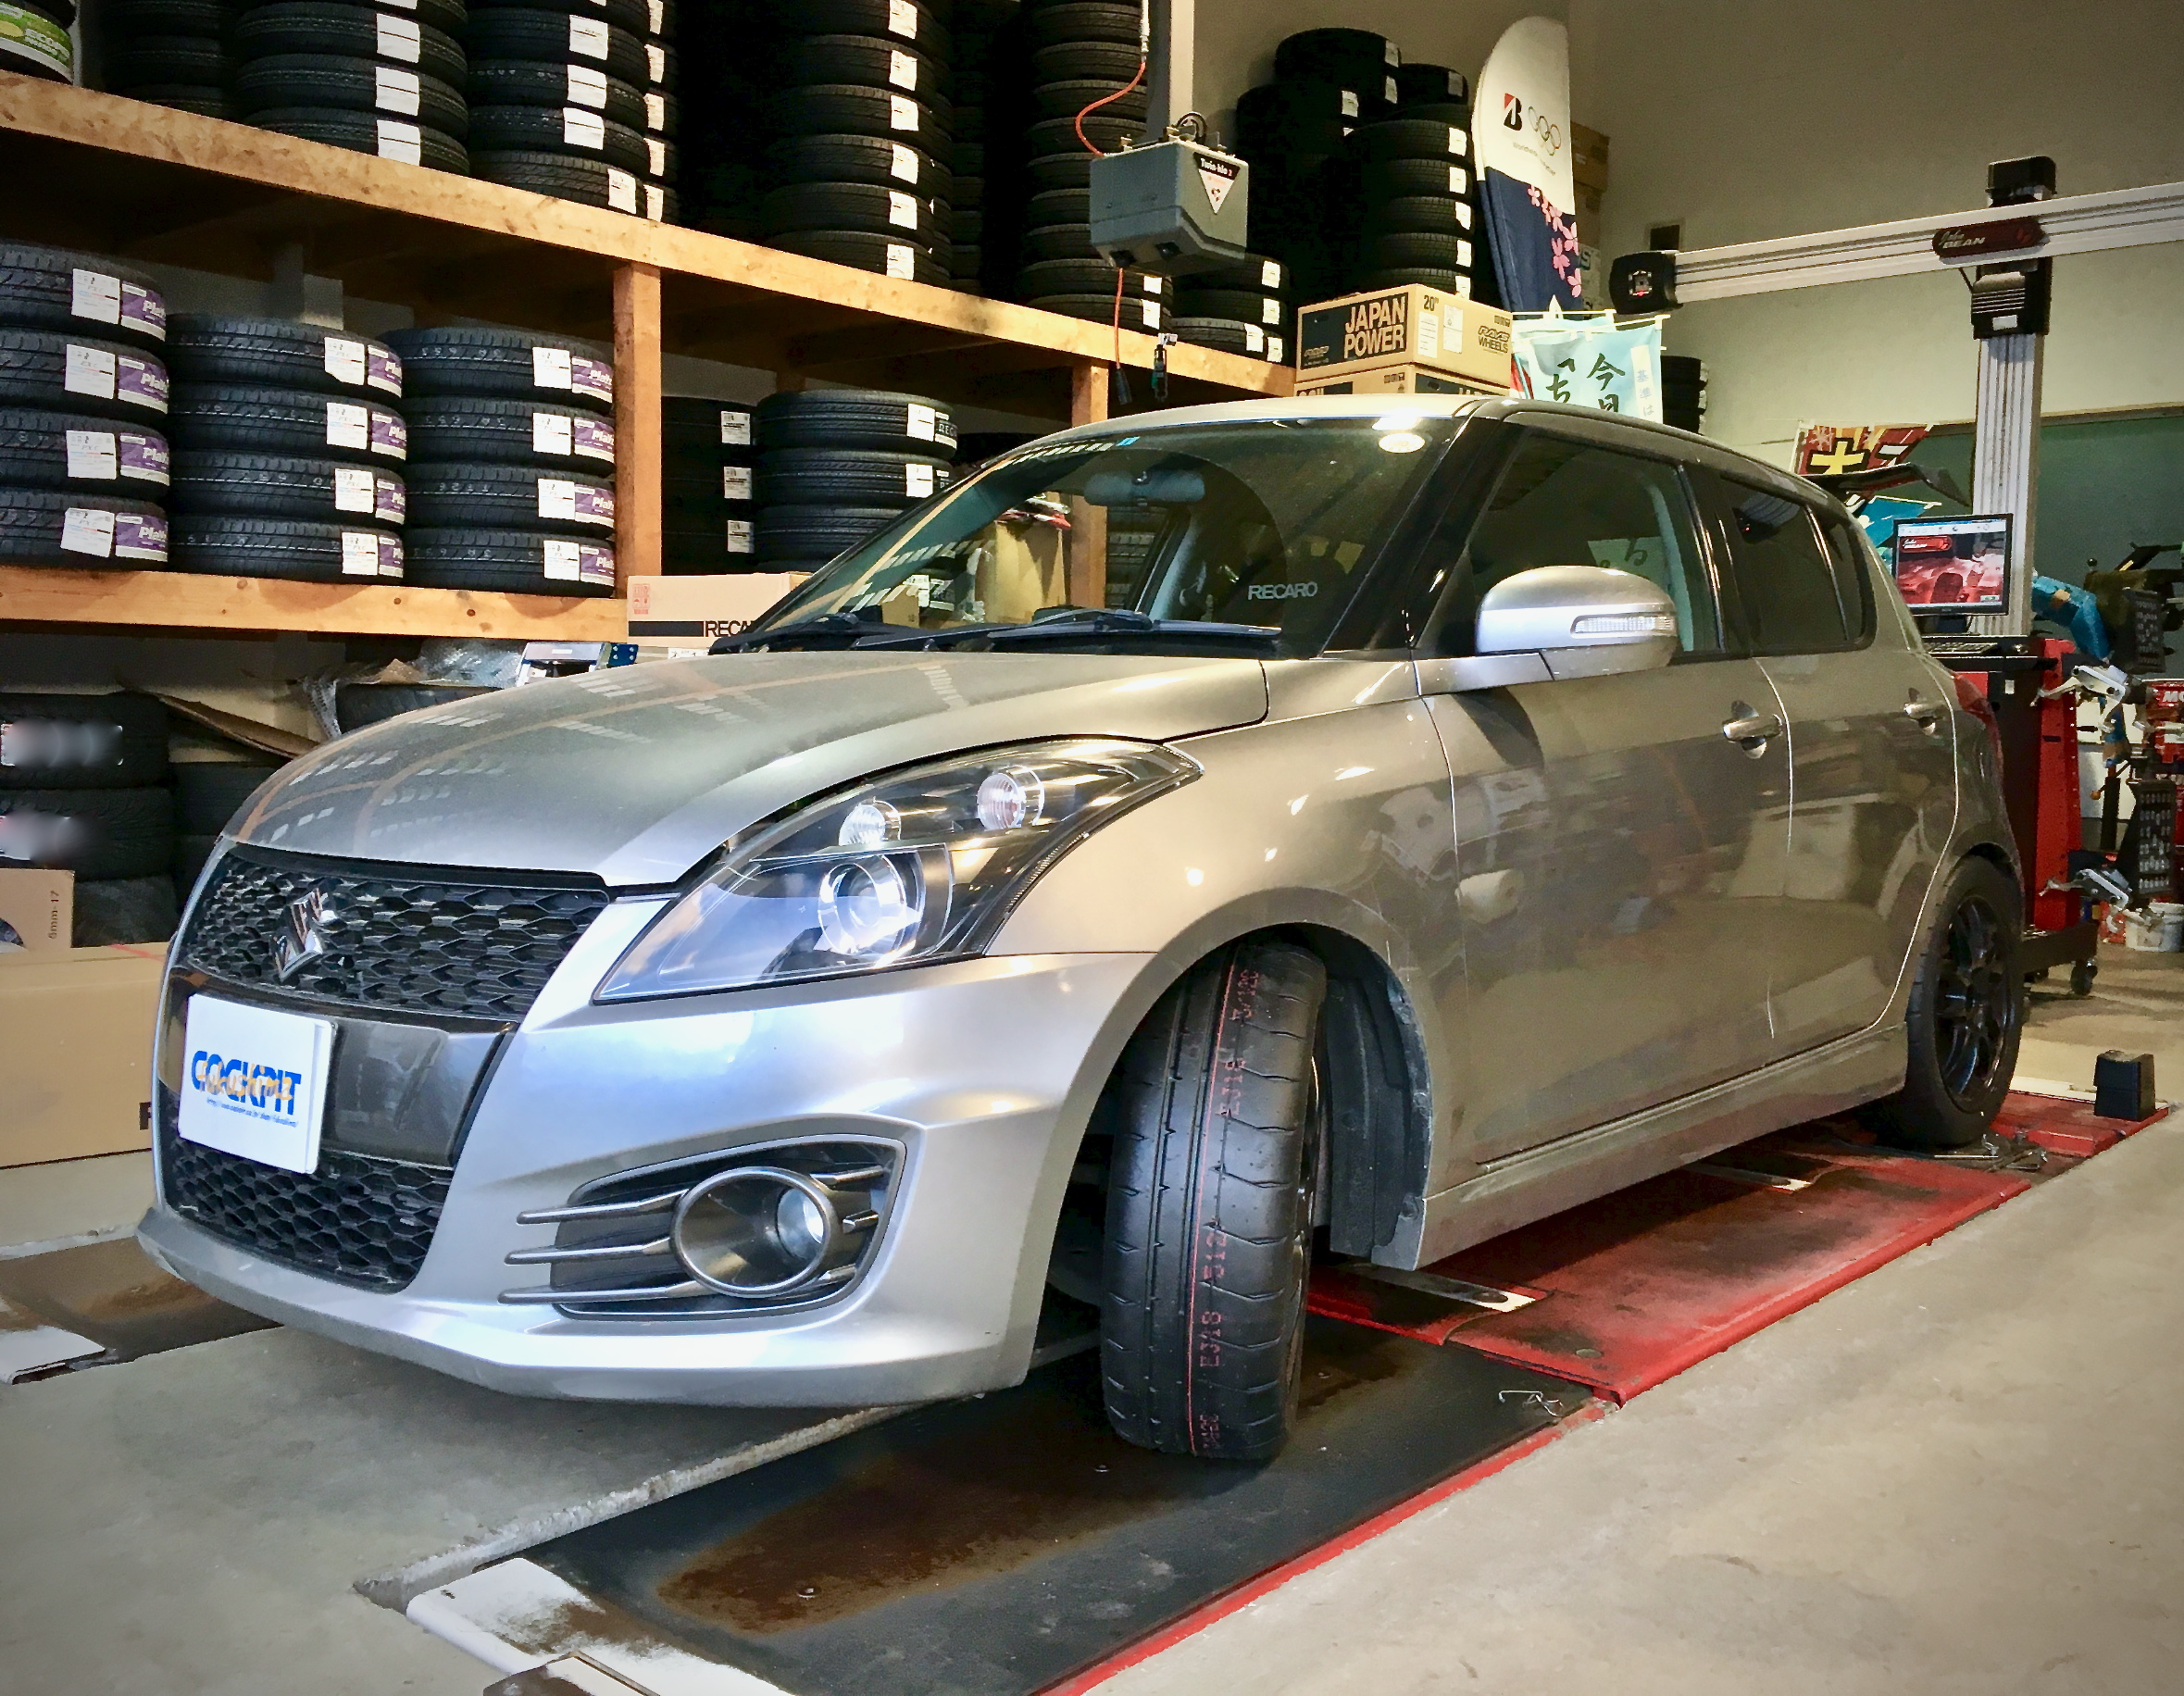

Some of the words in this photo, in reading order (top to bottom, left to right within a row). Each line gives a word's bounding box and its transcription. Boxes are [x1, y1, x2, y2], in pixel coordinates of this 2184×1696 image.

[1345, 296, 1405, 334] JAPAN
[1343, 324, 1404, 359] POWER
[1479, 335, 1509, 354] WHEELS
[1247, 581, 1318, 600] RECARO
[191, 1050, 303, 1116] COCKPIT
